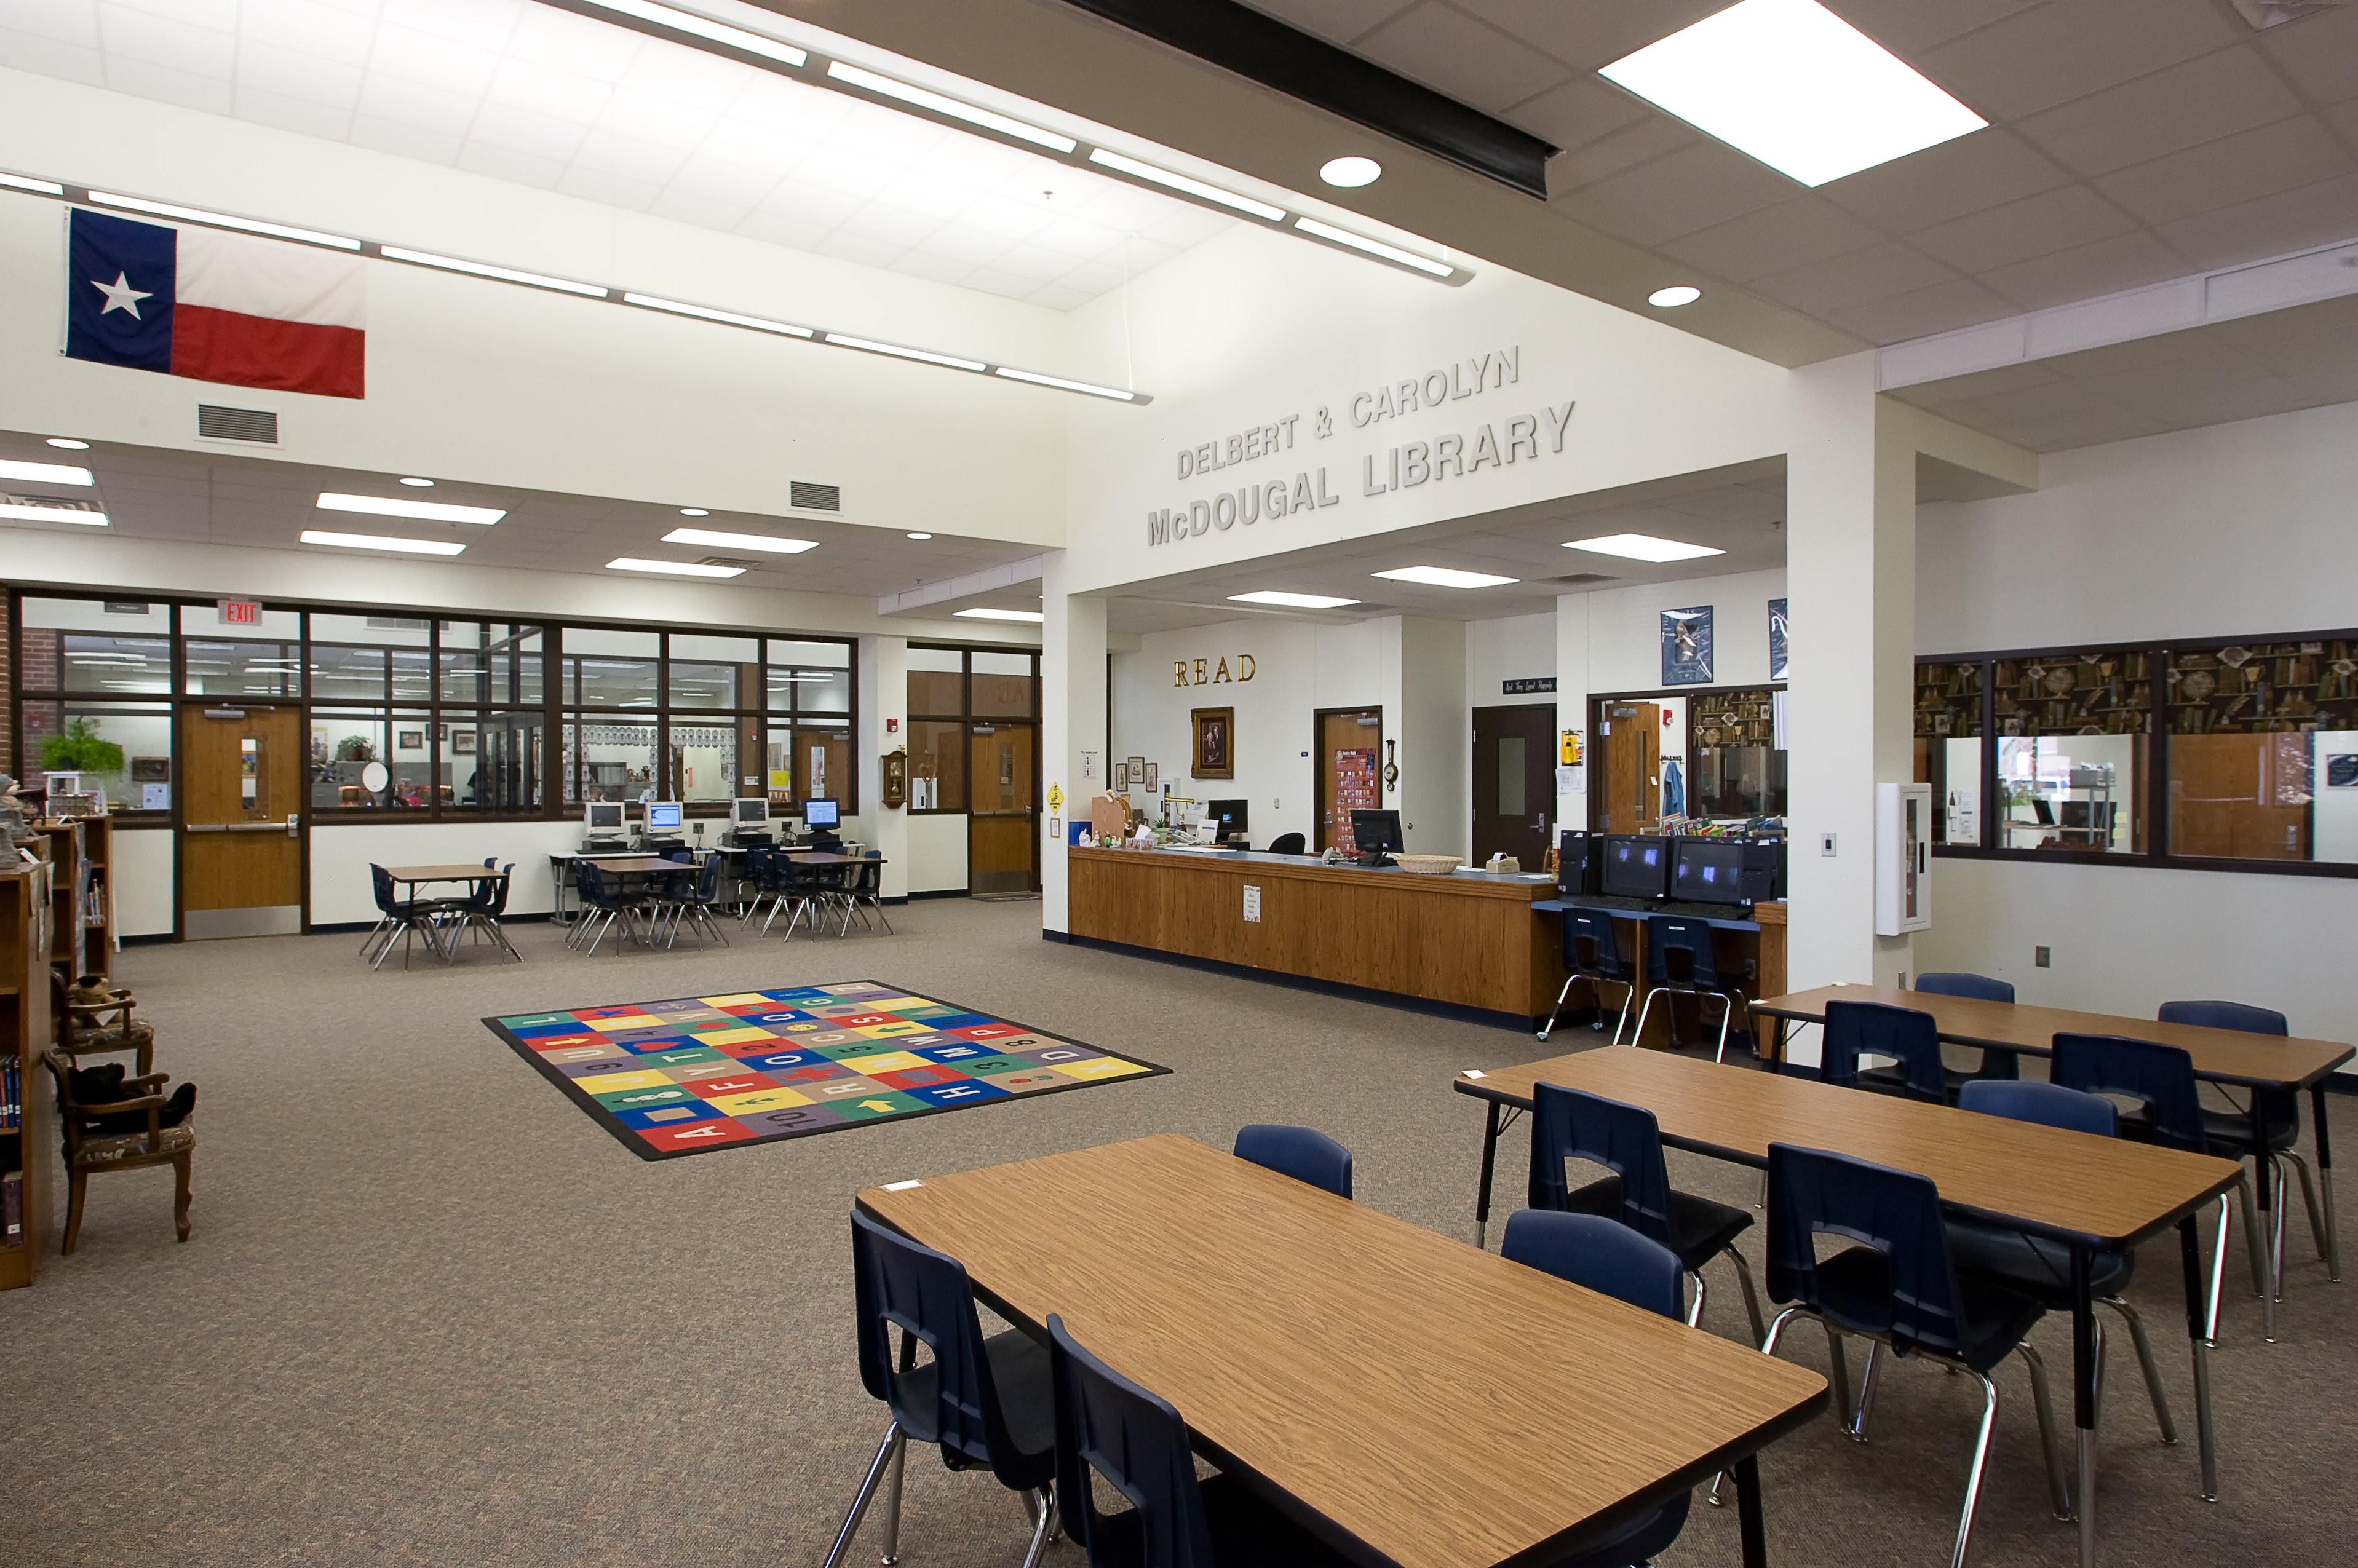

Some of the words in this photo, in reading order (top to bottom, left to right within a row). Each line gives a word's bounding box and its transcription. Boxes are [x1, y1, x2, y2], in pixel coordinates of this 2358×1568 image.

[1177, 414, 1299, 480] DELBERT
[1312, 406, 1333, 440] &
[1348, 345, 1518, 428] CAROLYN
[1147, 467, 1339, 547] McDOUGAL
[1363, 400, 1576, 496] LIBRARY
[227, 603, 255, 623] EXIT
[1173, 654, 1256, 687] READ
[900, 1035, 943, 1045] W
[563, 1050, 604, 1058] U
[662, 1053, 702, 1062] T
[933, 1047, 978, 1057] M
[1040, 1051, 1079, 1060] D
[764, 1055, 802, 1064] O
[865, 1057, 906, 1067] N
[684, 1067, 725, 1075] Y
[1078, 1063, 1119, 1074] X
[822, 1083, 866, 1094] R
[931, 1085, 980, 1098] H
[766, 1112, 817, 1127] 10
[673, 1125, 725, 1138] A
